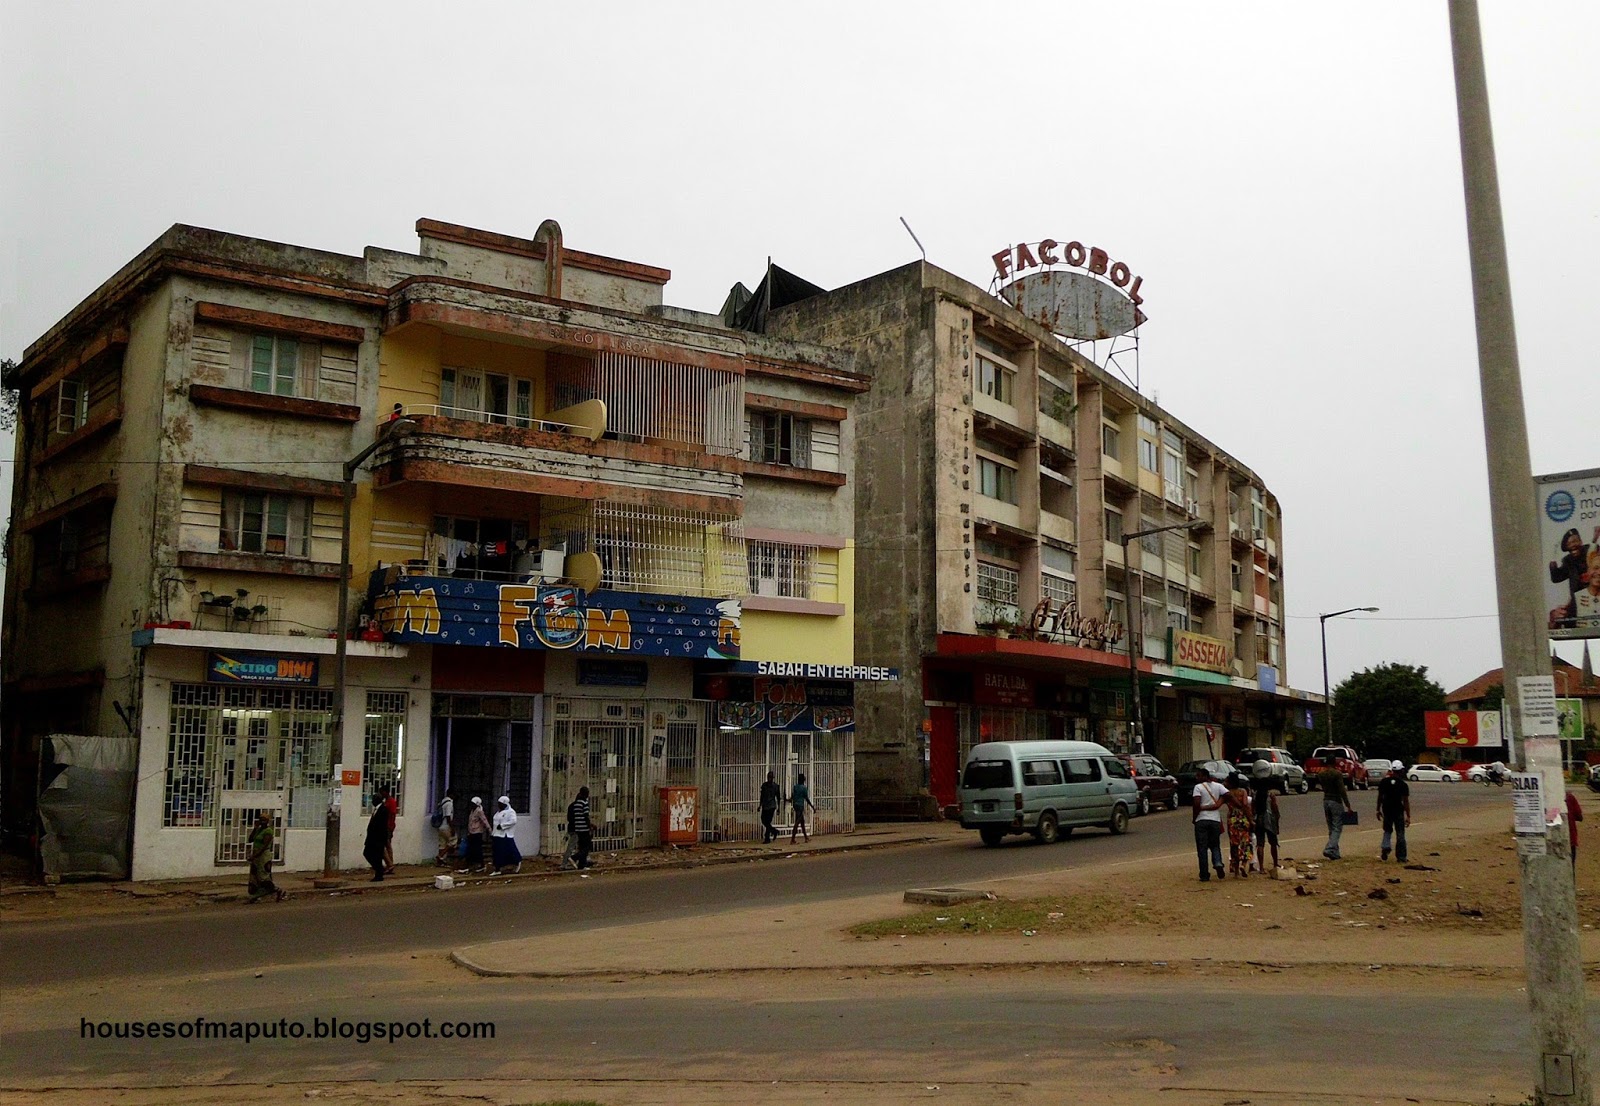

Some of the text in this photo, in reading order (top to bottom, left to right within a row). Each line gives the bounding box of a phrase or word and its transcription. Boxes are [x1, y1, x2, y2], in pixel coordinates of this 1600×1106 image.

[992, 238, 1144, 305] FACOBOL
[499, 584, 631, 650] FOM
[1179, 636, 1227, 667] SASSEKA
[215, 661, 277, 674] ELECTRO
[757, 660, 803, 676] SABAH
[807, 664, 889, 681] ENTERPRISE
[754, 677, 807, 705] FOM
